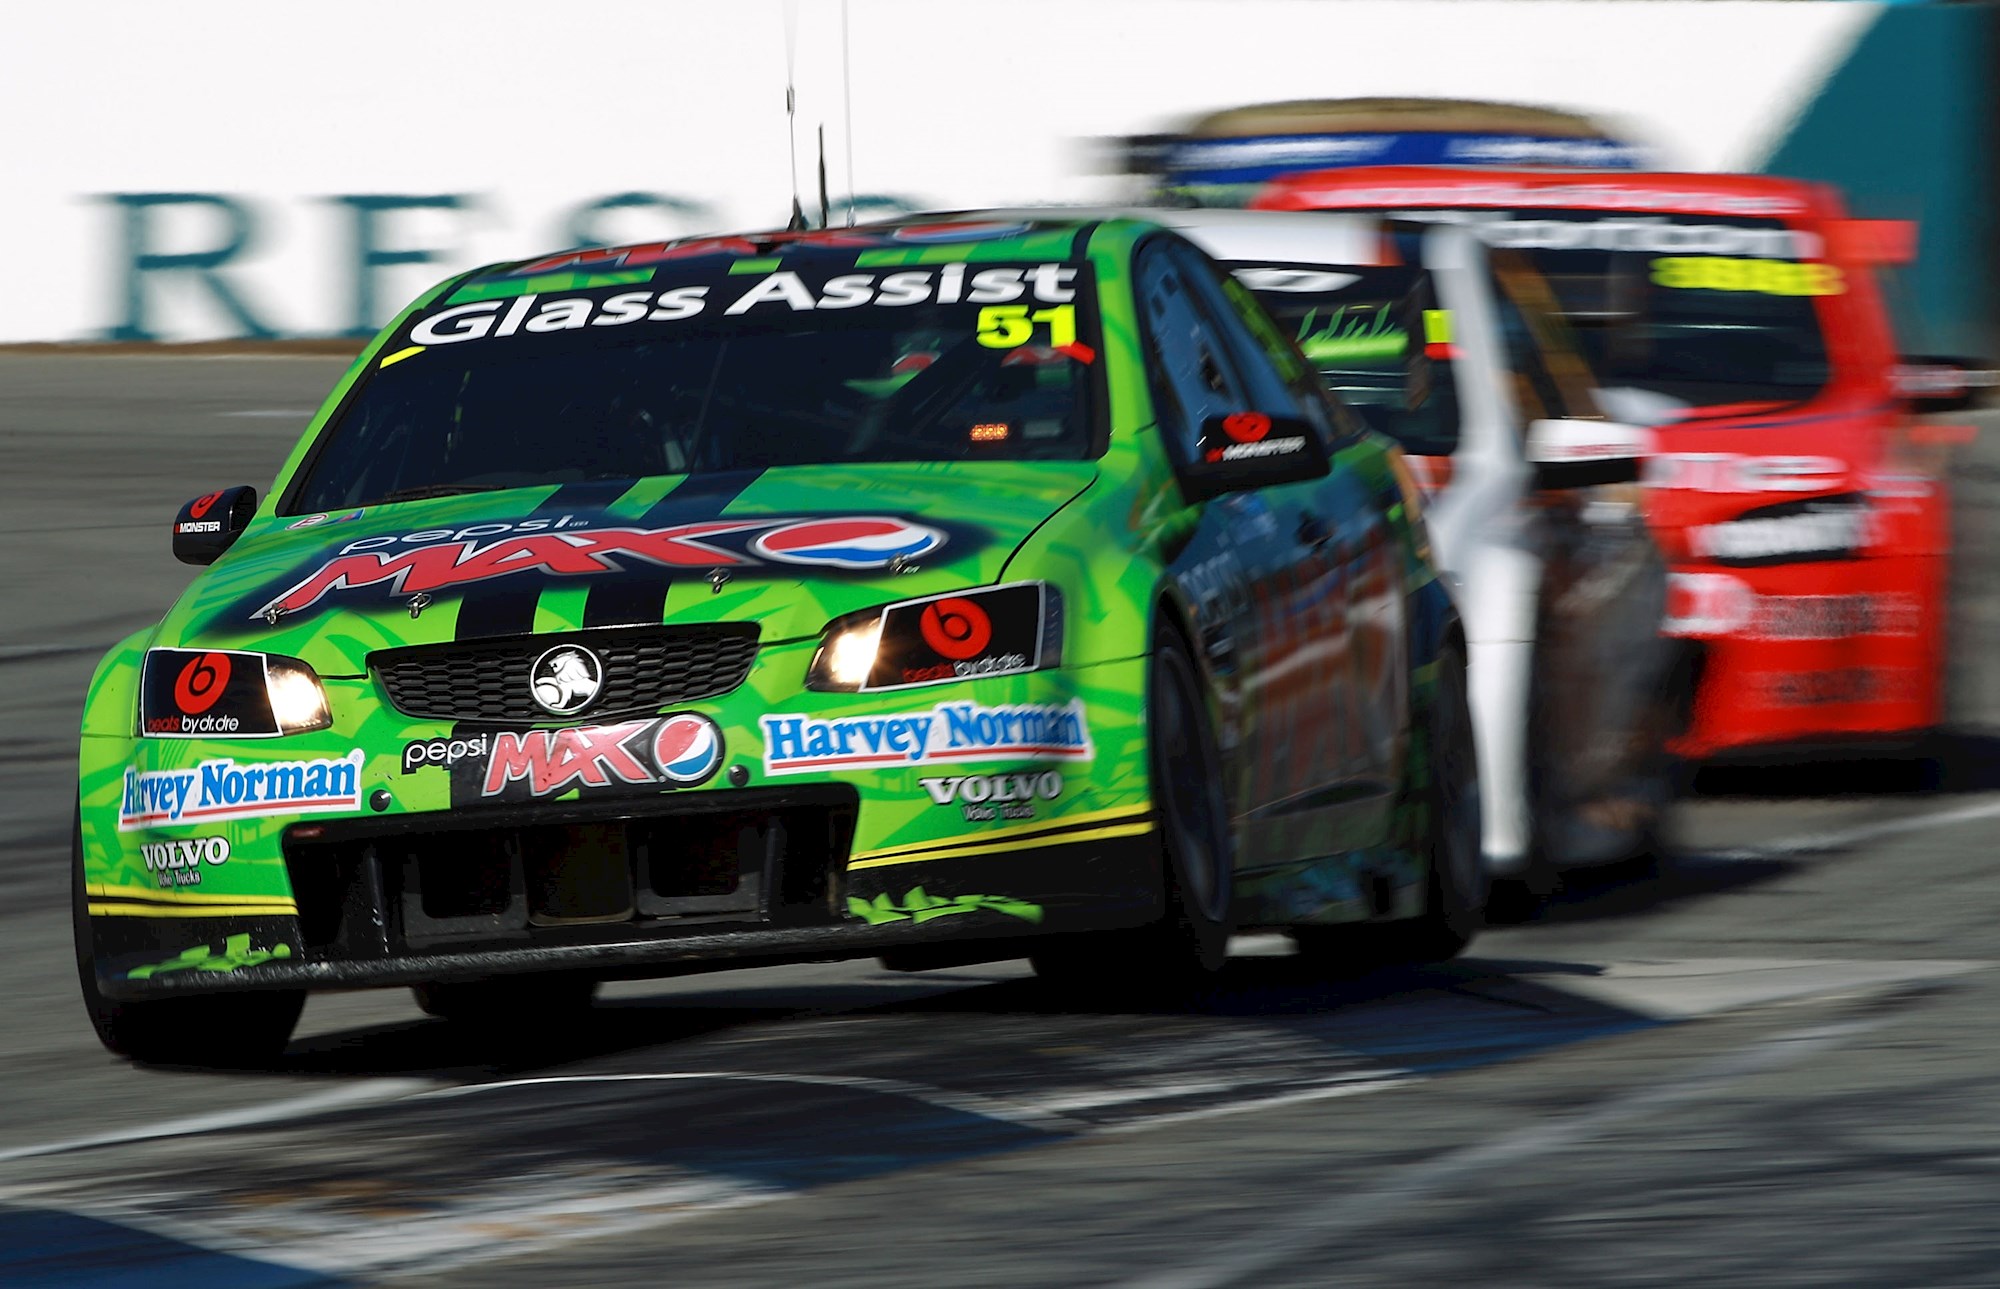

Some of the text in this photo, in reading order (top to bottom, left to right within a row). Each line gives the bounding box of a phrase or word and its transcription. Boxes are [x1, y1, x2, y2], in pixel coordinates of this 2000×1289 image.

[410, 262, 1078, 347] Glass Assist
[976, 304, 1077, 349] 51
[179, 520, 221, 534] MONSTER
[338, 514, 574, 556] pepsi
[251, 519, 785, 619] MAX
[181, 714, 200, 735] by
[765, 705, 1083, 761] Harvey Norman
[405, 716, 663, 798] pepsi MAX
[122, 761, 356, 820] Harvey Norman
[919, 770, 1064, 804] VOLVO
[140, 836, 231, 872] VOLVO
